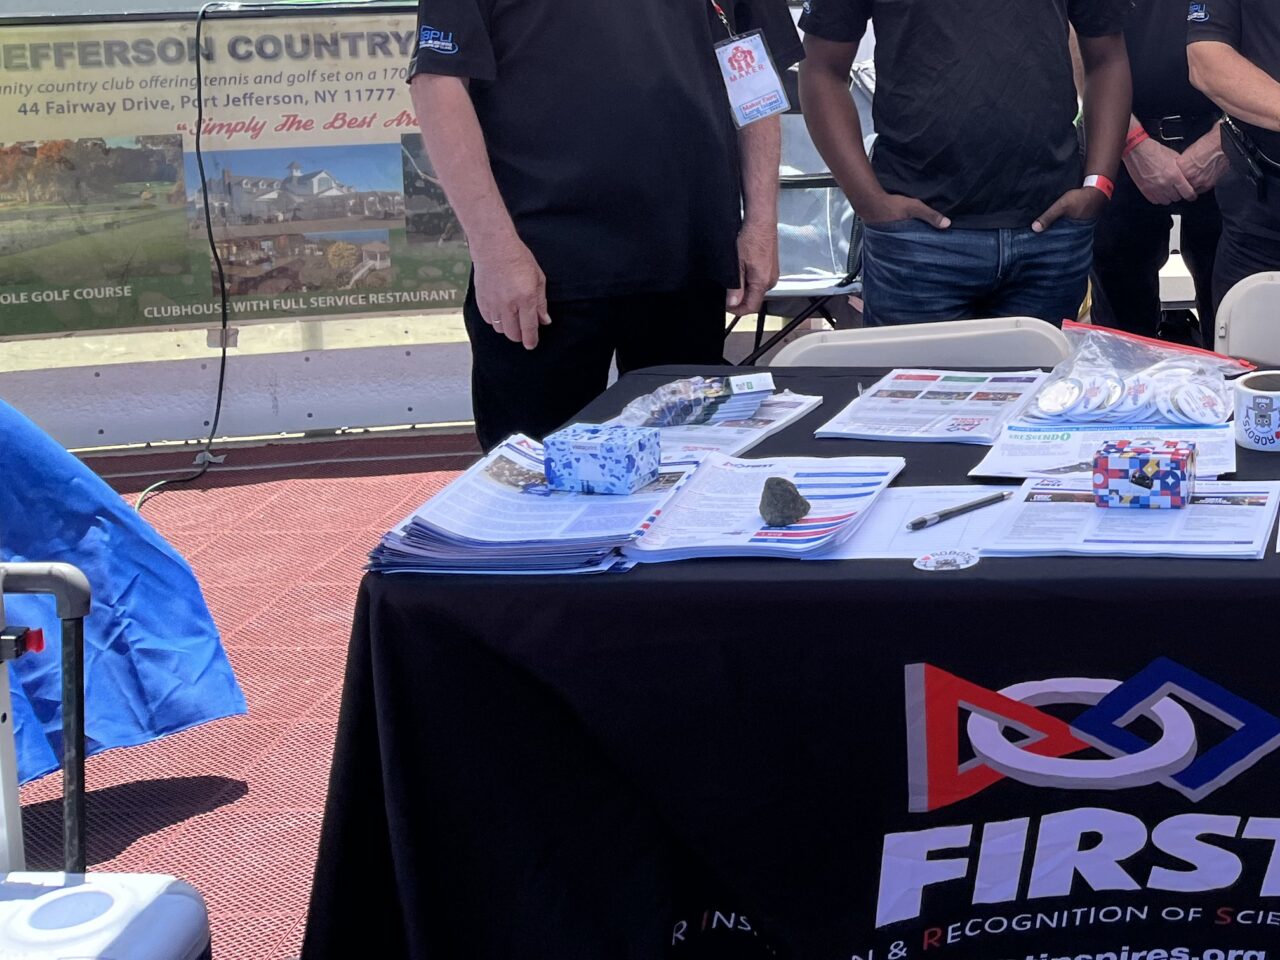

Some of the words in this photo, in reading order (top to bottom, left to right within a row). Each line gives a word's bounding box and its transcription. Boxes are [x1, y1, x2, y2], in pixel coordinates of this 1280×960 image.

[228, 31, 415, 62] COUNTRY
[0, 81, 33, 97] nity
[37, 79, 98, 94] country
[103, 77, 134, 91] club
[139, 75, 198, 91] offering
[204, 72, 249, 86] tennis
[254, 71, 283, 84] and
[287, 70, 317, 86] golf
[320, 70, 340, 82] set
[345, 71, 363, 81] on
[367, 71, 376, 80] a
[729, 63, 767, 82] MAKER
[18, 102, 40, 115] 44
[46, 100, 116, 115] Fairway
[122, 97, 175, 111] Drive,
[181, 95, 218, 109] Port
[223, 92, 309, 107] Jefferson,
[314, 90, 338, 104] NY
[344, 88, 395, 102] 11777
[274, 113, 315, 132] The
[323, 111, 377, 130] Best
[31, 289, 70, 302] GOLF
[73, 286, 132, 300] COURSE
[143, 302, 230, 318] CLUBHOUSE
[232, 300, 270, 313] WITH
[273, 297, 307, 310] FULL
[310, 294, 366, 308] SERVICE
[369, 289, 457, 304] RESTAURANT
[1243, 420, 1276, 446] ROBOTS
[702, 910, 752, 932] INS
[888, 941, 907, 960] &
[923, 905, 1148, 951] RECOGNITION
[1161, 906, 1203, 921] OF
